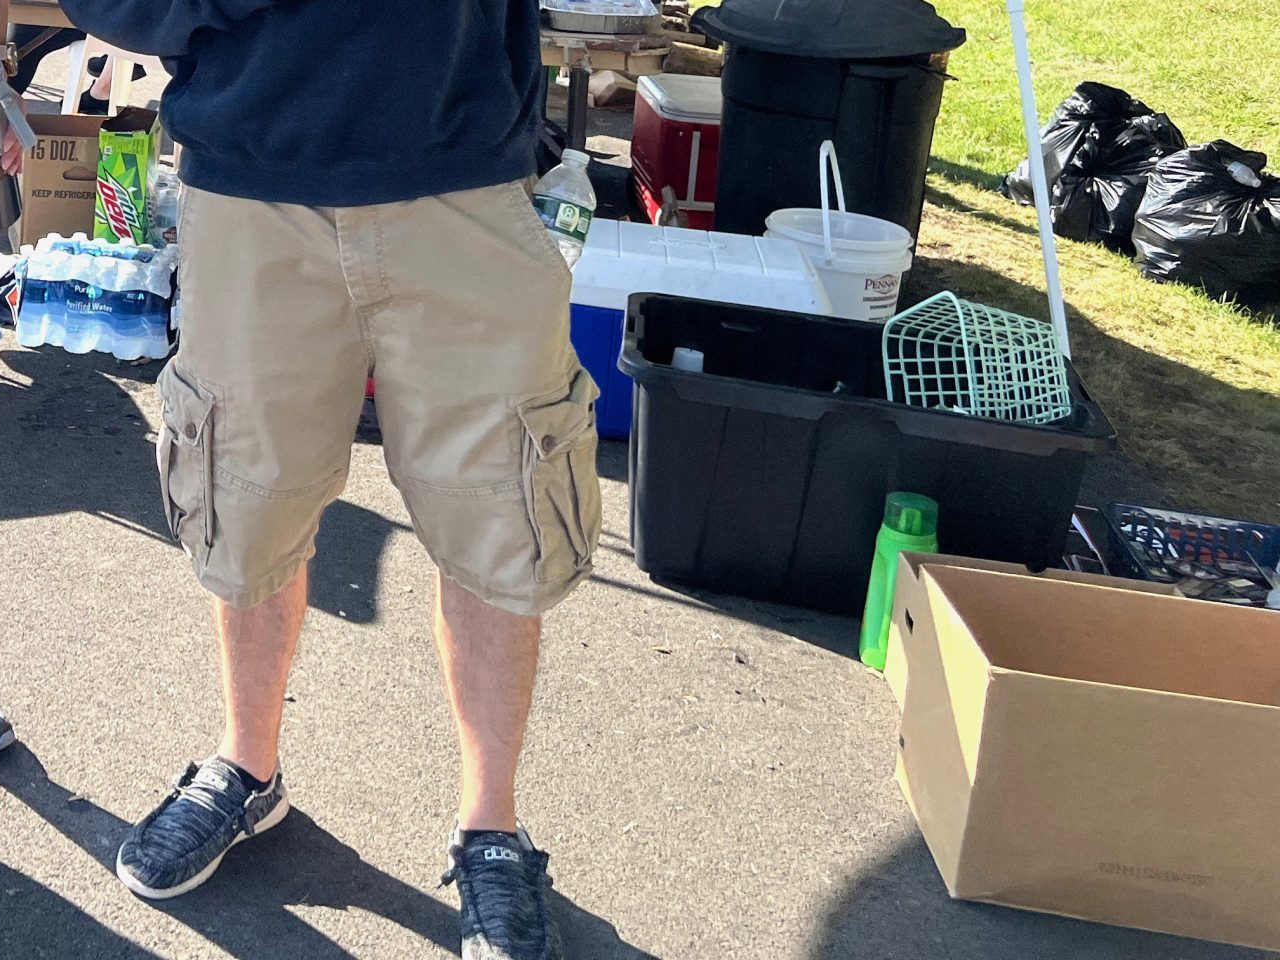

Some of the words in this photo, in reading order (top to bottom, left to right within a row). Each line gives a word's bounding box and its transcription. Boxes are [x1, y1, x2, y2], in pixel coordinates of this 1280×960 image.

[50, 140, 79, 161] DOZ.
[32, 189, 52, 198] KEEP
[66, 299, 91, 311] Purified
[91, 302, 113, 313] Water
